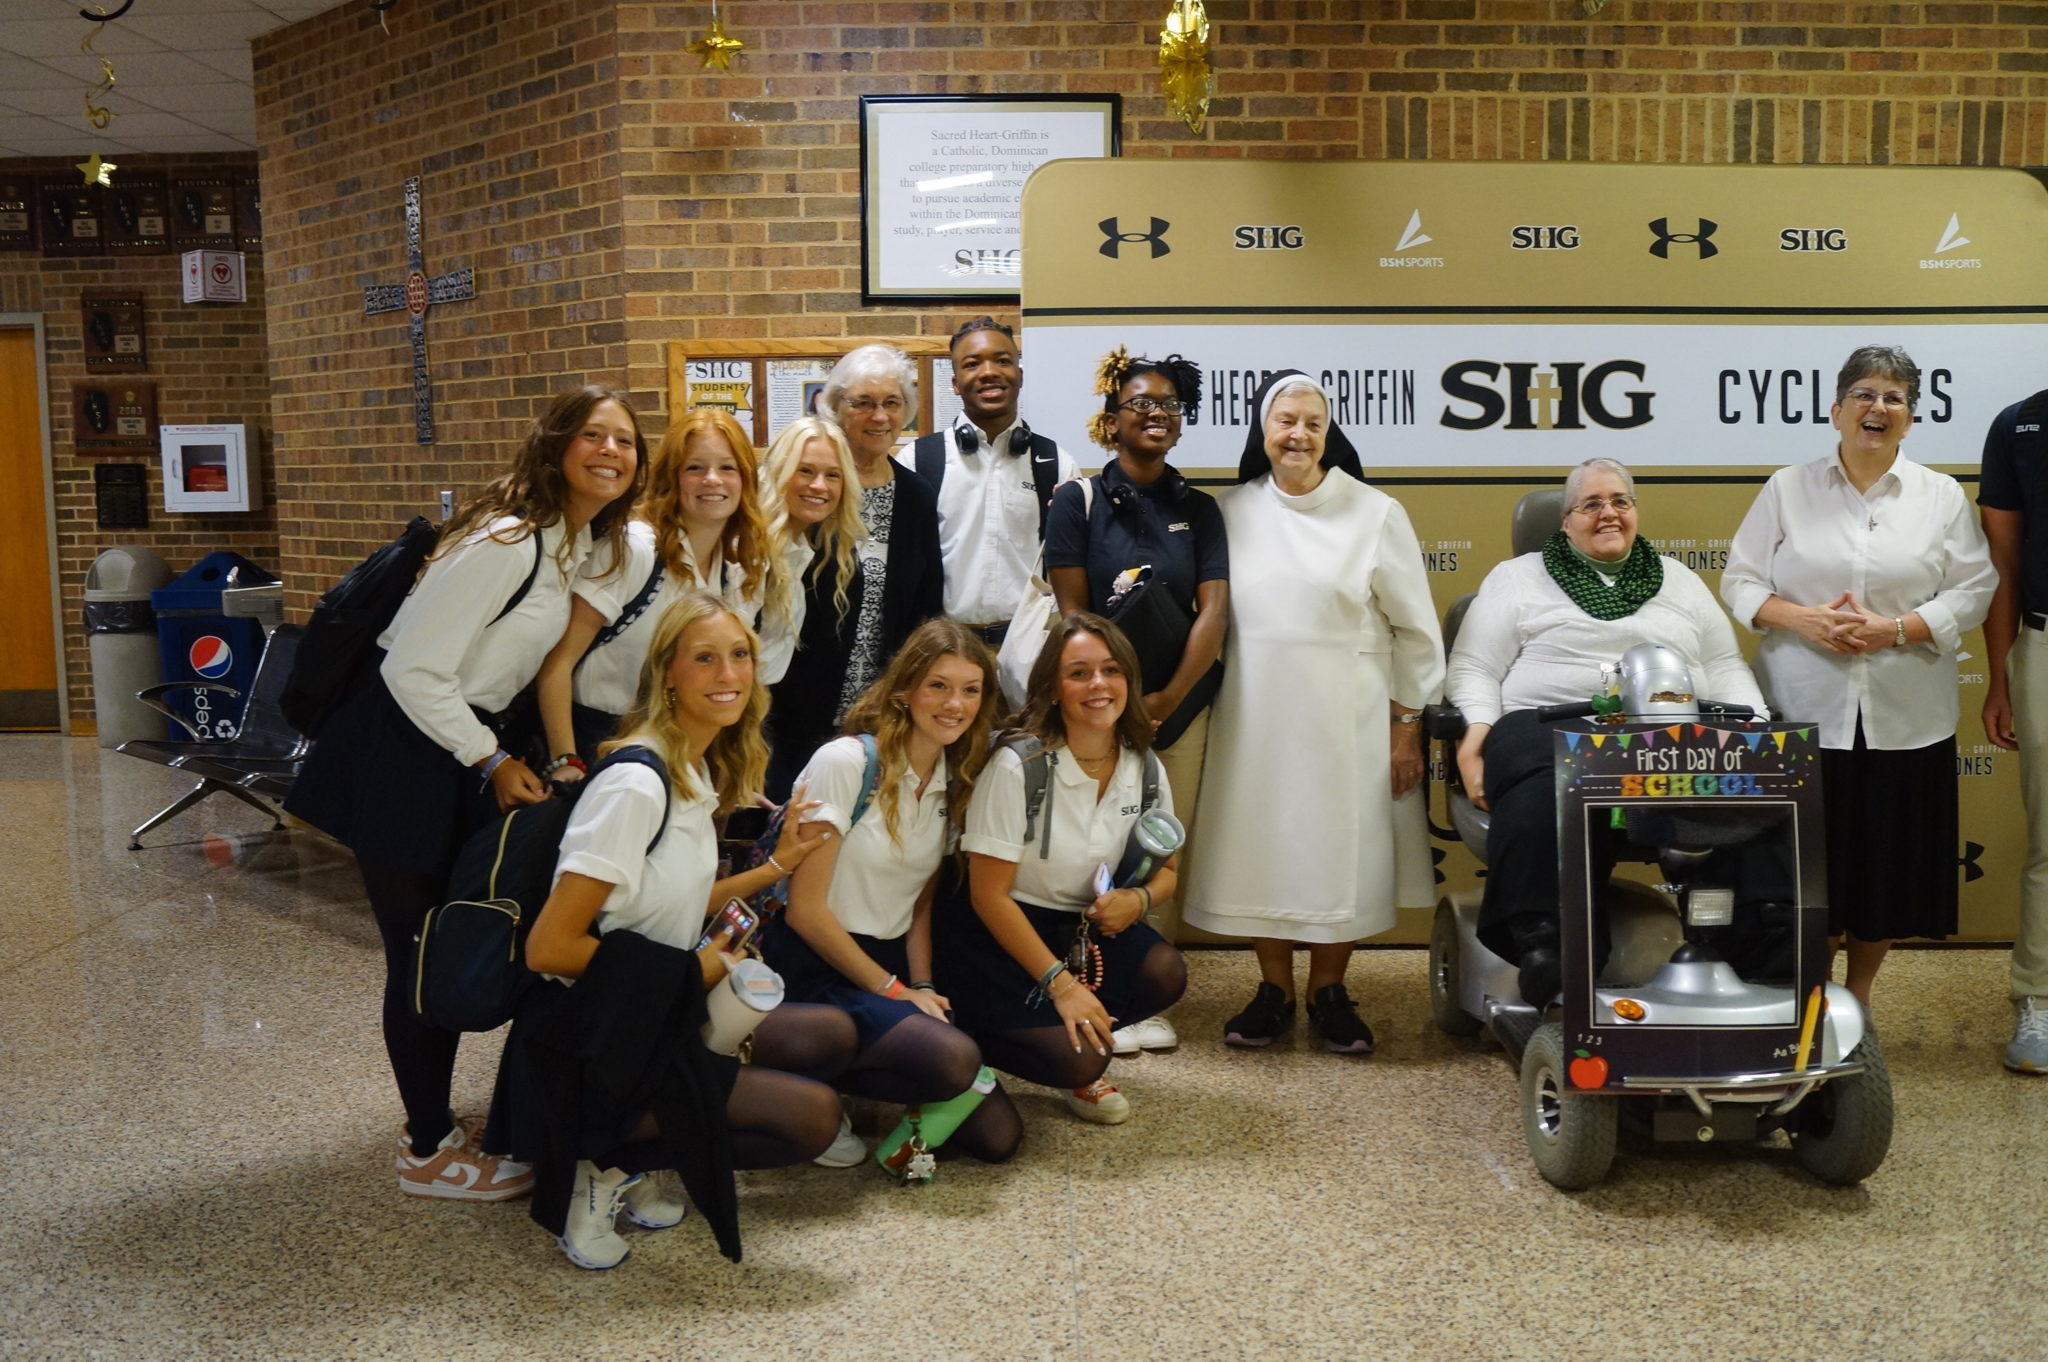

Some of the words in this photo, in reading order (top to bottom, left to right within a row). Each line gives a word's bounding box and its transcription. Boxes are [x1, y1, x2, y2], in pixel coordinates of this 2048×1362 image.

[931, 129, 966, 140] Sacred
[969, 129, 1037, 140] Heart-Griffin
[1040, 130, 1049, 140] is
[932, 147, 938, 156] a
[941, 145, 988, 157] Catholic,
[991, 145, 1049, 156] Dominican
[909, 161, 947, 174] college
[949, 162, 1009, 174] preparatory
[1011, 161, 1035, 174] high
[900, 177, 918, 188] tha
[912, 194, 923, 204] to
[925, 195, 960, 207] pursue
[962, 193, 1011, 204] academic
[910, 209, 943, 220] within
[945, 209, 962, 219] the
[894, 225, 924, 238] study,
[927, 228, 963, 238] pyer,
[966, 225, 1002, 235] service
[1233, 226, 1304, 250] SHG
[1510, 226, 1580, 250] SHG
[1779, 228, 1848, 252] SHG
[696, 362, 743, 379] SHG
[771, 360, 812, 370] STUDENT
[691, 383, 746, 392] STUDENTS
[701, 392, 714, 400] OF
[716, 392, 733, 400] THE
[1211, 370, 1268, 425] HEA
[1440, 359, 1656, 431] SHG
[1437, 541, 1472, 550] GRIFFIN
[1669, 539, 1696, 548] HEART
[194, 687, 214, 739] peps
[1723, 745, 1745, 771] of
[1620, 773, 1765, 797] SCHOOL
